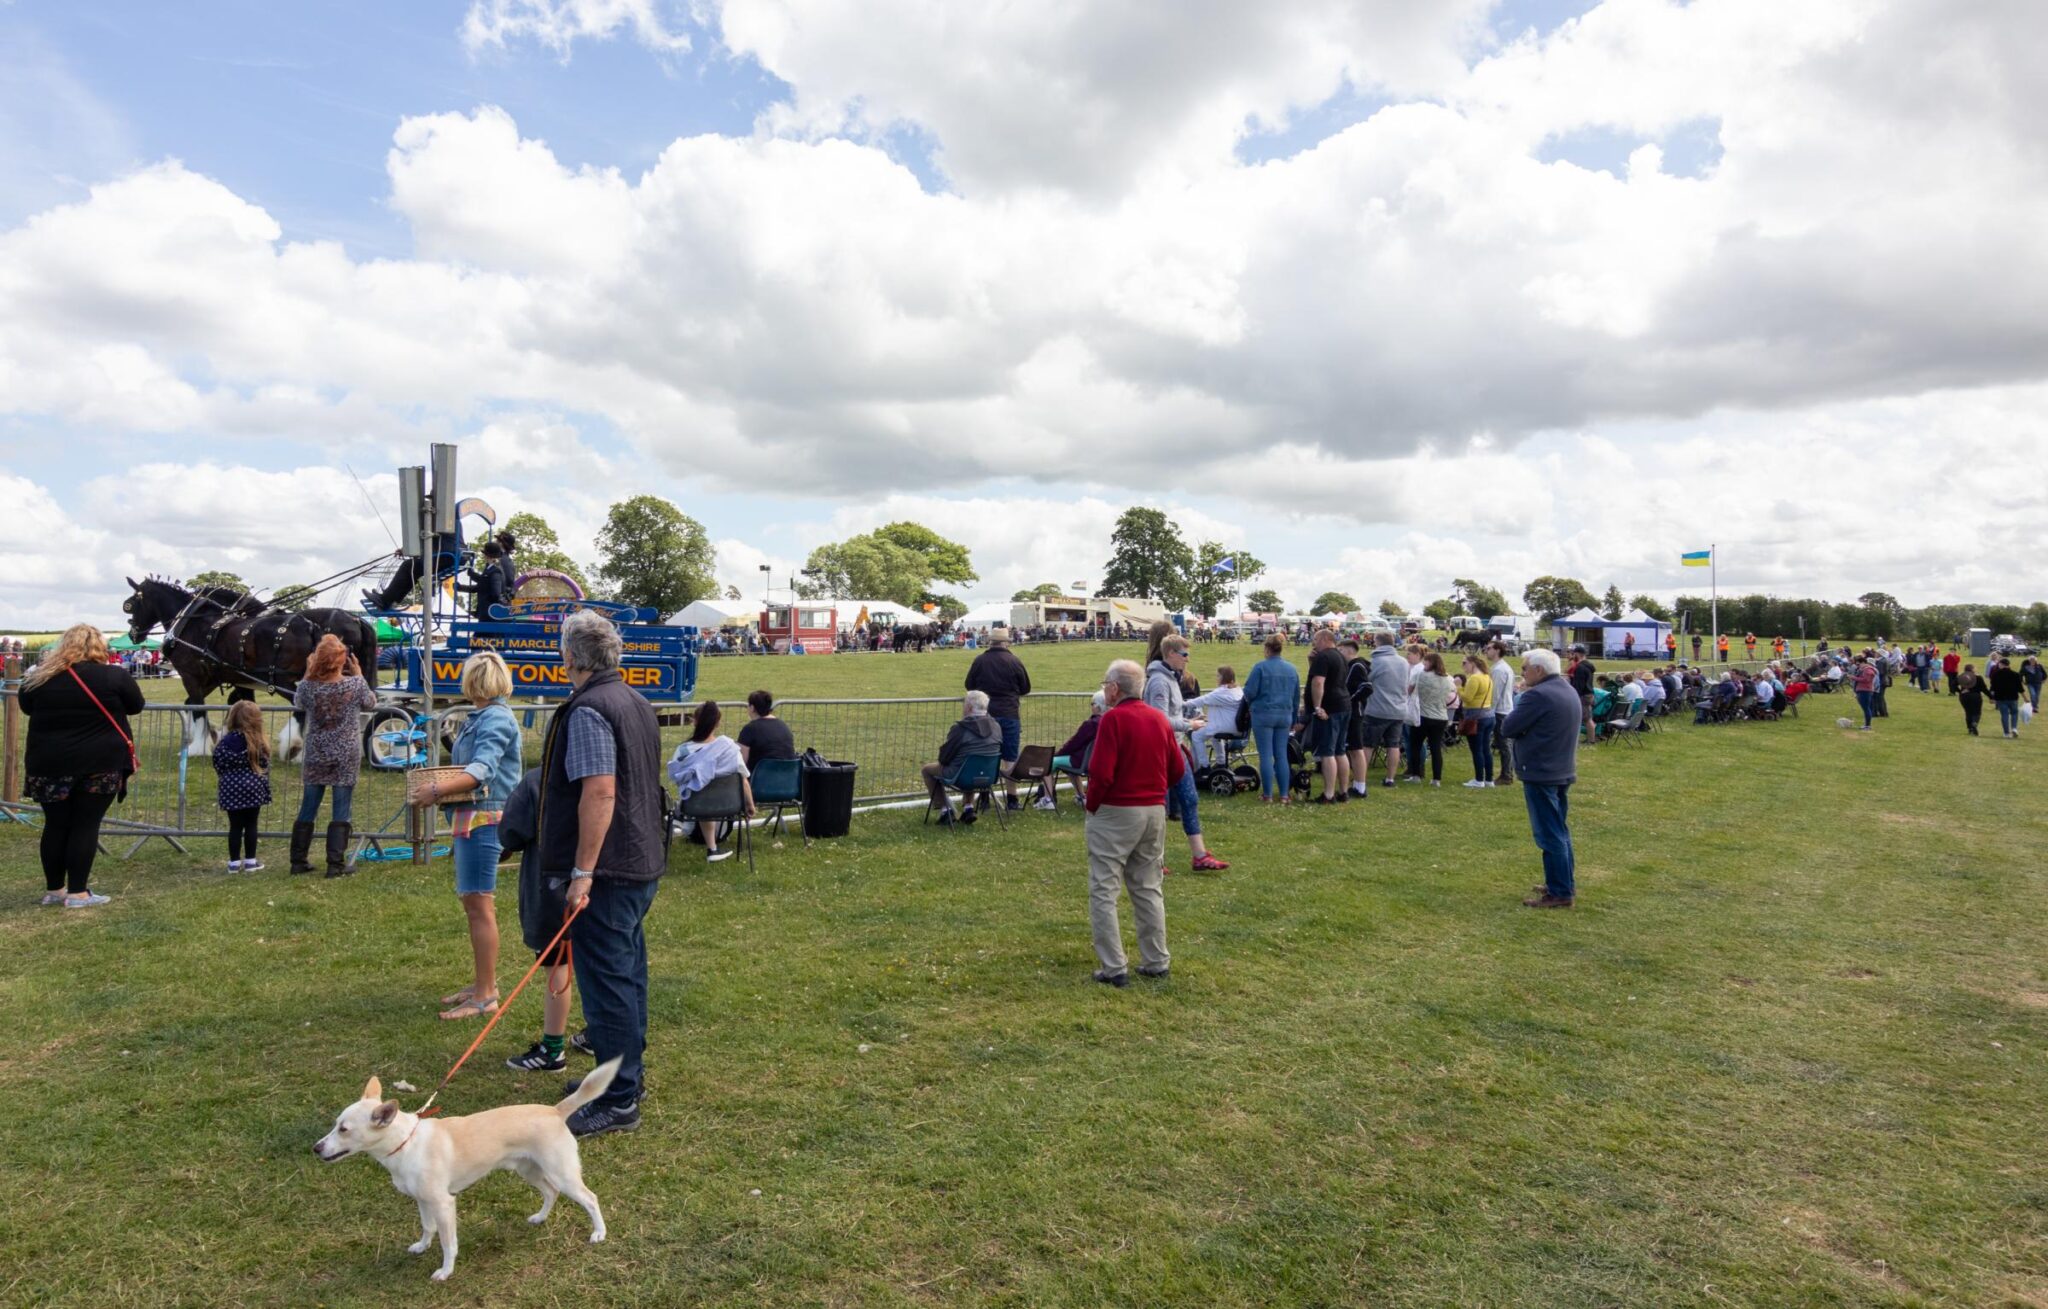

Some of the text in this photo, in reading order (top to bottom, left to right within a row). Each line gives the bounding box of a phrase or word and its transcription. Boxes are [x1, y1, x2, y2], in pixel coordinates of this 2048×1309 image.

[557, 602, 569, 615] of
[470, 638, 661, 652] MUCH MARCLE DSHIRE
[433, 661, 662, 686] WTONS DER
